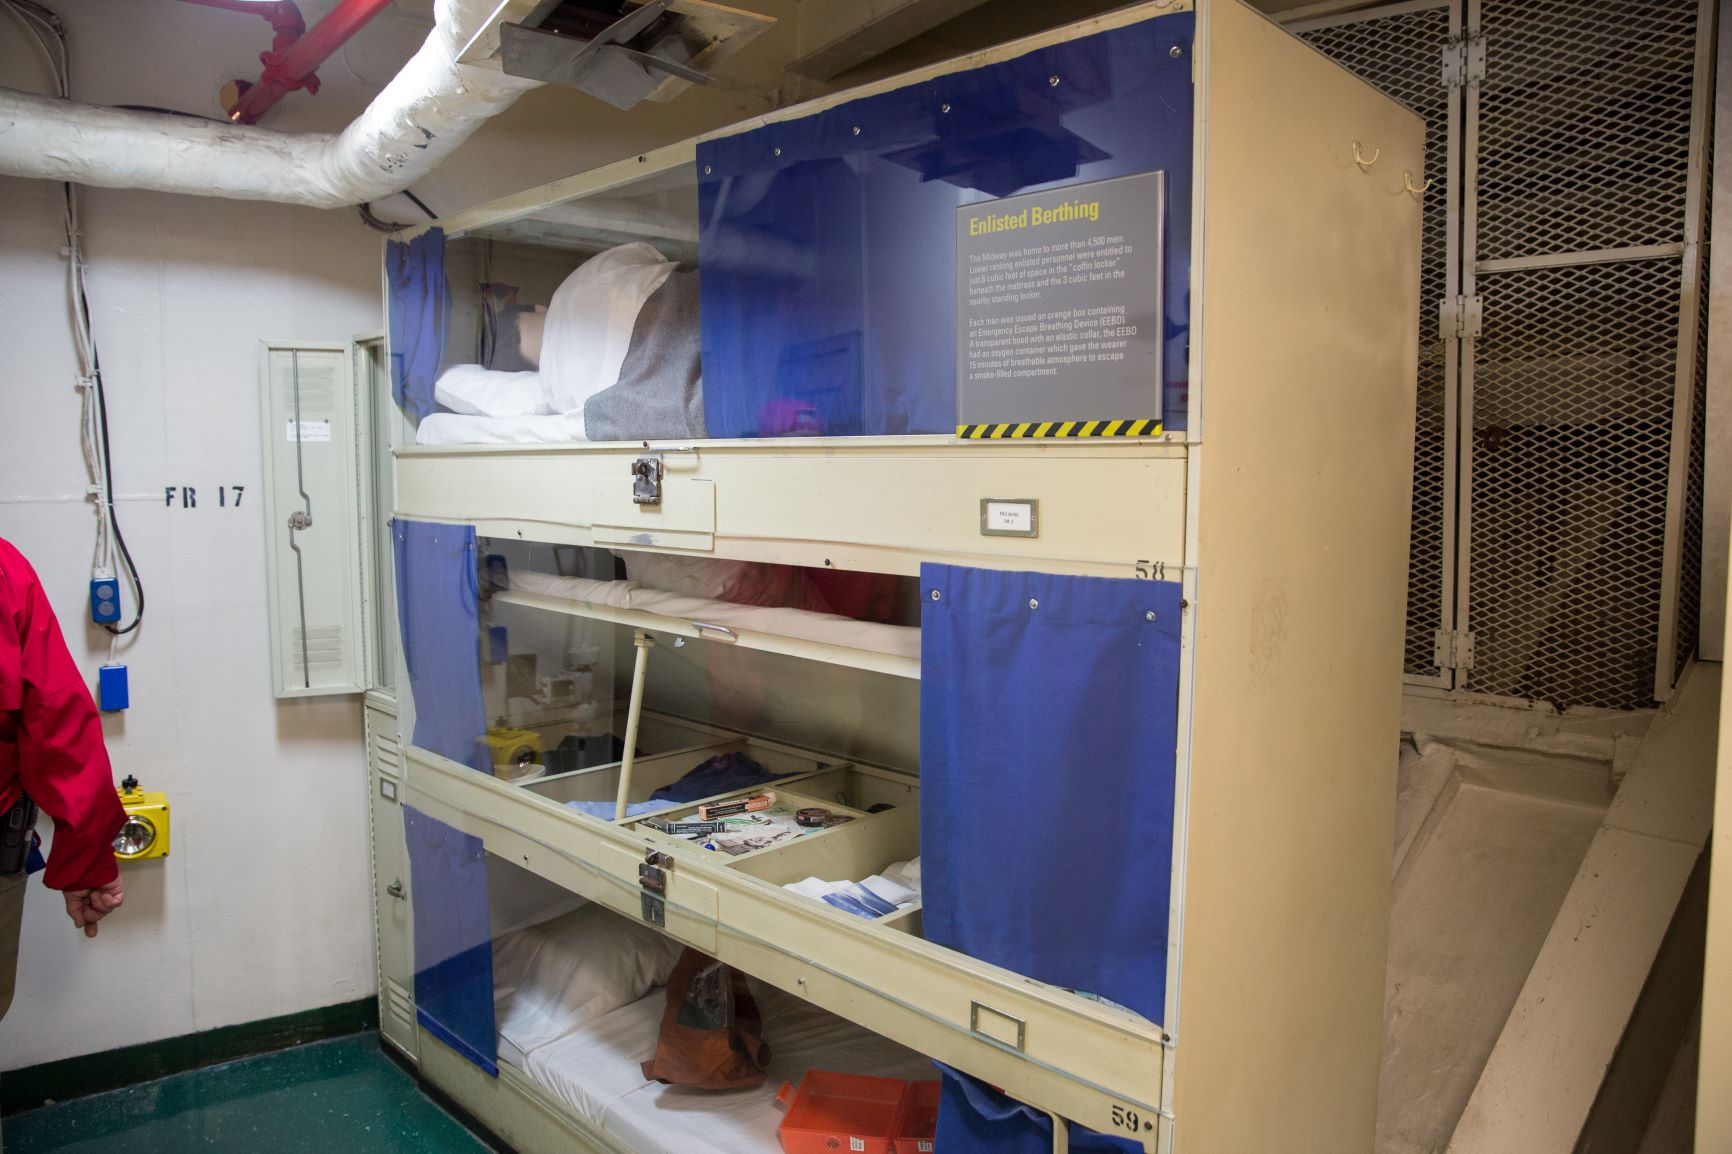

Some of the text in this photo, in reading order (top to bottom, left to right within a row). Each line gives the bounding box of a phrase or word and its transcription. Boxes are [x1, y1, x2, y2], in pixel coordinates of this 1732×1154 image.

[970, 200, 1100, 236] Enlisted Berthing
[970, 254, 981, 263] The
[982, 252, 1008, 262] Midway
[1009, 250, 1022, 258] was
[1024, 247, 1041, 256] home
[1043, 245, 1050, 253] to
[1052, 243, 1069, 252] more
[1071, 240, 1086, 249] than
[1088, 236, 1106, 247] 4,500
[970, 245, 1133, 274] Lower ranking enlisted personnel were entitled to
[969, 269, 1125, 296] beneath the mattress and the 3 cubic feet in the
[970, 276, 980, 286] just
[987, 272, 1004, 282] cubic
[1006, 271, 1018, 280] feet
[1020, 269, 1026, 279] of
[1027, 267, 1047, 278] space
[1048, 265, 1055, 275] in
[1056, 264, 1067, 274] the
[969, 297, 990, 306] nearby
[992, 294, 1019, 303] standing
[969, 318, 985, 327] Each
[986, 317, 999, 326] man
[1000, 316, 1014, 324] was
[1015, 313, 1036, 323] issued
[1047, 310, 1072, 320] orange
[1073, 308, 1086, 317] box
[1087, 305, 1125, 316] containing
[969, 330, 977, 338] an
[978, 327, 1013, 338] Emergency
[1014, 325, 1038, 334] Escape
[1039, 321, 1073, 331] Breathing
[1074, 319, 1098, 328] Device
[969, 339, 975, 348] A
[975, 338, 1011, 348] transparent
[1012, 335, 1029, 345] hood
[1029, 333, 1045, 343] with
[1046, 334, 1055, 342] an
[1055, 332, 1078, 341] elastic
[1103, 328, 1115, 337] the
[1116, 326, 1137, 336] EEBD
[969, 350, 980, 358] had
[991, 349, 1014, 358] oxygen
[1015, 346, 1046, 356] container
[1047, 343, 1068, 353] which
[1069, 343, 1087, 353] gave
[1087, 341, 1099, 350] the
[1100, 340, 1127, 350] wearer
[969, 352, 1124, 369] 15 minutes of breathable atmosphere to escape
[974, 369, 1012, 380] smoke-filled
[165, 486, 245, 509] FR 17
[1135, 559, 1165, 580] 58
[1111, 1104, 1139, 1132] 59
